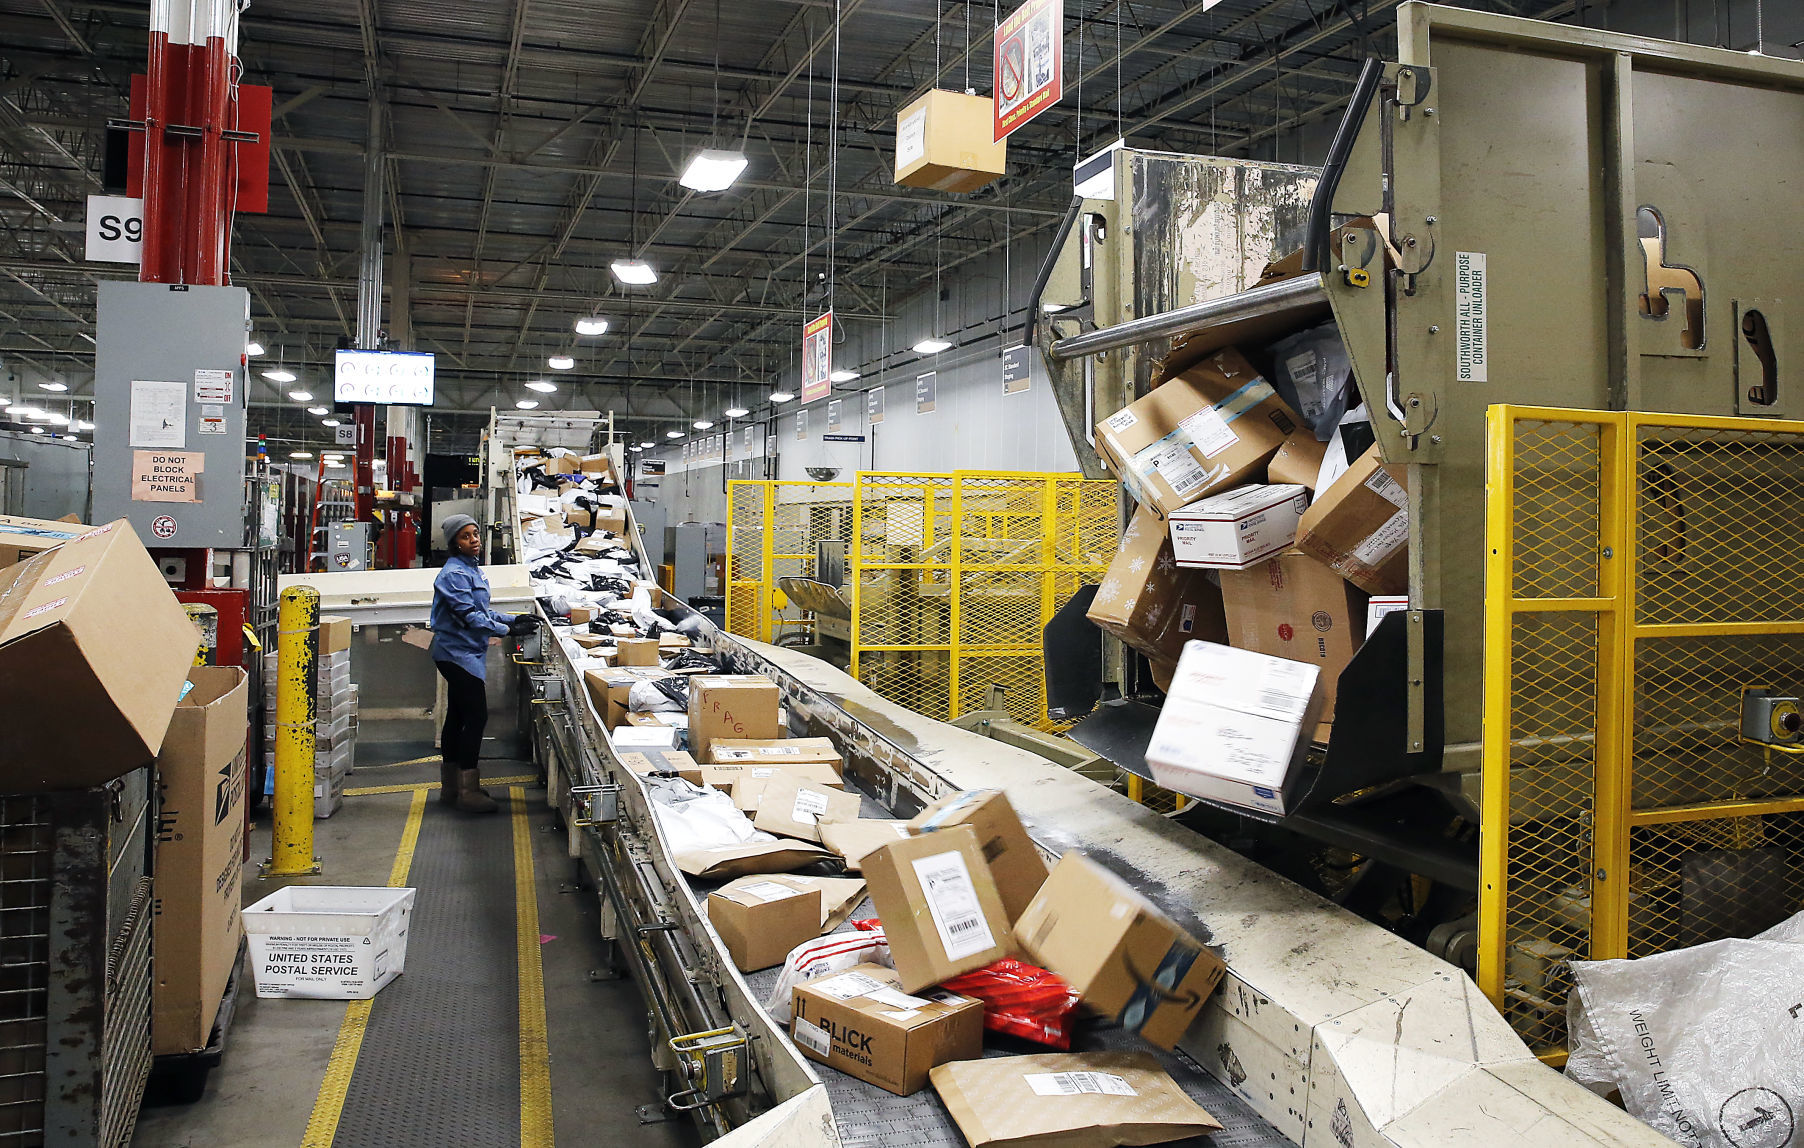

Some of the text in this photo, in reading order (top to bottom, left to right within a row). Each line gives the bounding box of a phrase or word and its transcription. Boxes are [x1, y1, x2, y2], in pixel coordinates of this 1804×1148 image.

[99, 215, 142, 242] S9
[1459, 254, 1470, 293] PURPOSE
[1460, 302, 1470, 317] ALL
[1471, 270, 1483, 365] CONTAINER UNLOADER
[1460, 320, 1471, 379] SOUTHWORTH
[209, 422, 217, 432] 3
[338, 429, 353, 438] S8
[141, 475, 194, 483] ELECTRICAL
[150, 484, 185, 492] PANELS
[268, 953, 353, 964] UNITED STATES
[265, 965, 358, 975] POSTAL SERVICE
[820, 1017, 873, 1055] BLICK
[832, 1044, 873, 1067] materials
[1629, 1009, 1697, 1140] WEIGHT LIMIT NOT
